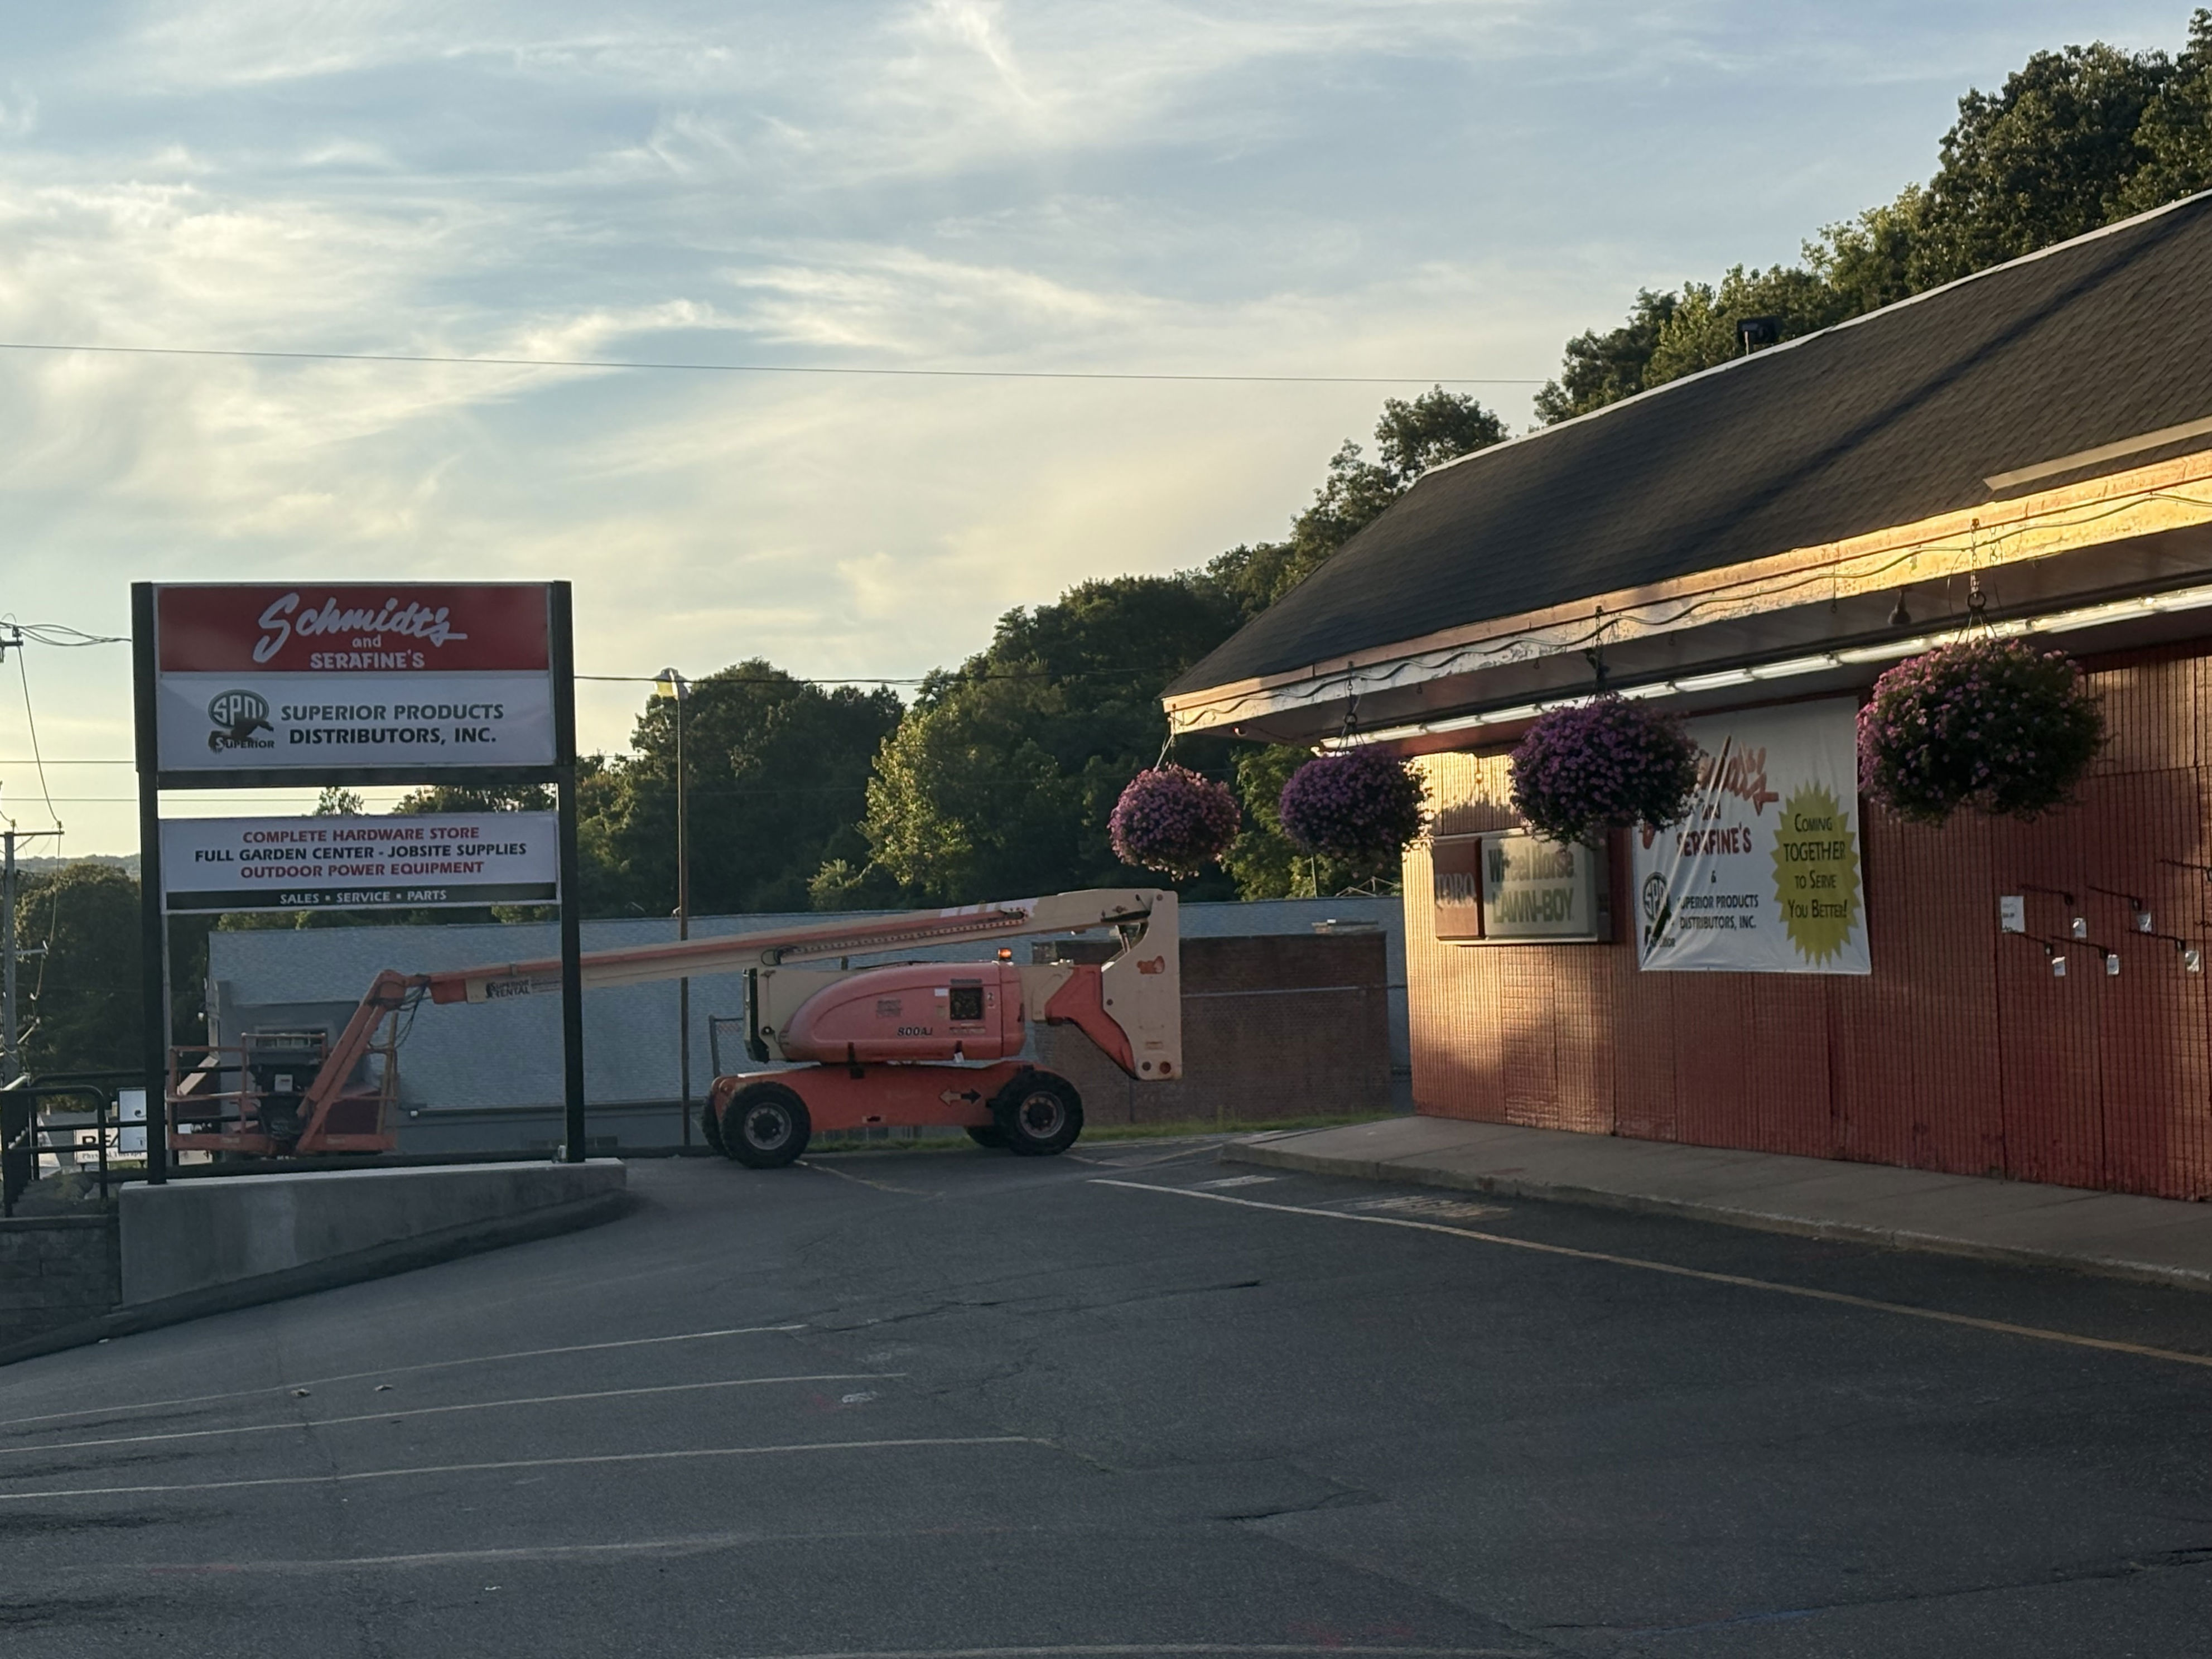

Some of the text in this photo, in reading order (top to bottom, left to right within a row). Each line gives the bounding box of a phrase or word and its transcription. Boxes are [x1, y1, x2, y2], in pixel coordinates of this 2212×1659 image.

[253, 592, 468, 663] Schmidt's
[352, 634, 382, 648] and
[310, 649, 425, 669] SERAFINE'S
[281, 704, 504, 721] SUPERIOR PRODUCTS
[215, 737, 275, 749] SUPERIOR
[290, 727, 496, 745] DISTRIBUTORS, INC.
[242, 827, 479, 843] COMPLETE HARDWARE STORE
[195, 850, 234, 862] FULL
[239, 848, 306, 861] GARDEN
[312, 847, 374, 860] CENTER
[387, 845, 451, 858] JOBSITE
[457, 843, 527, 856] SUPPLIES
[1784, 841, 1845, 862] TOGETHER
[240, 861, 484, 878] OUTDOOR POWER EQUIPMENT
[280, 890, 447, 904] SALES SERVICE PARTS
[1492, 887, 1574, 923] LAWN-BOY
[1676, 894, 1759, 909] UPERIOR PRODUCTS
[1680, 915, 1756, 930] DISTRIBUTORS, INC.
[897, 1027, 933, 1036] 800AJ
